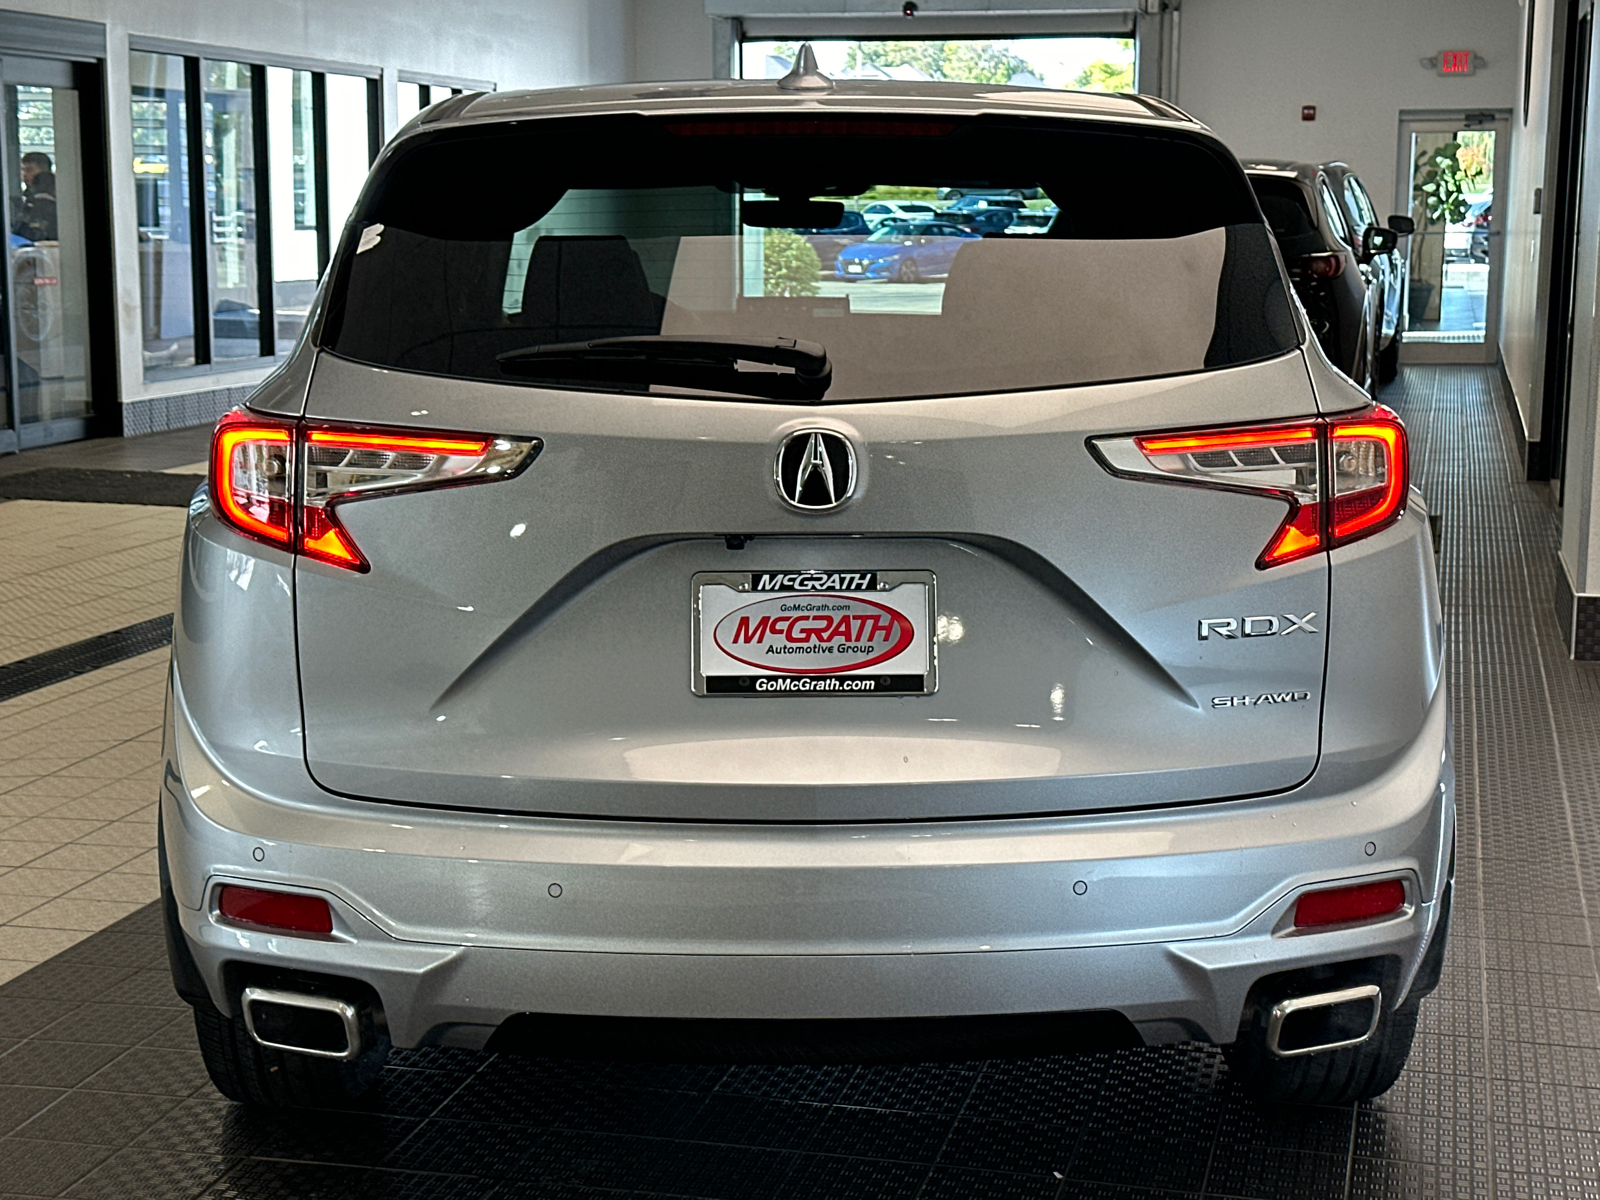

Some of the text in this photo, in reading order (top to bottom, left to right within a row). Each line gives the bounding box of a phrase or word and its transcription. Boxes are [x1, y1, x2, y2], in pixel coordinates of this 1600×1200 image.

[1443, 51, 1470, 72] EXIT
[780, 603, 850, 612] GoMcGrath.com
[1198, 611, 1319, 641] RDX
[765, 643, 874, 656] Automotive Group
[755, 677, 875, 693] GoMcGrath.com
[1211, 691, 1311, 709] SH-AWD
